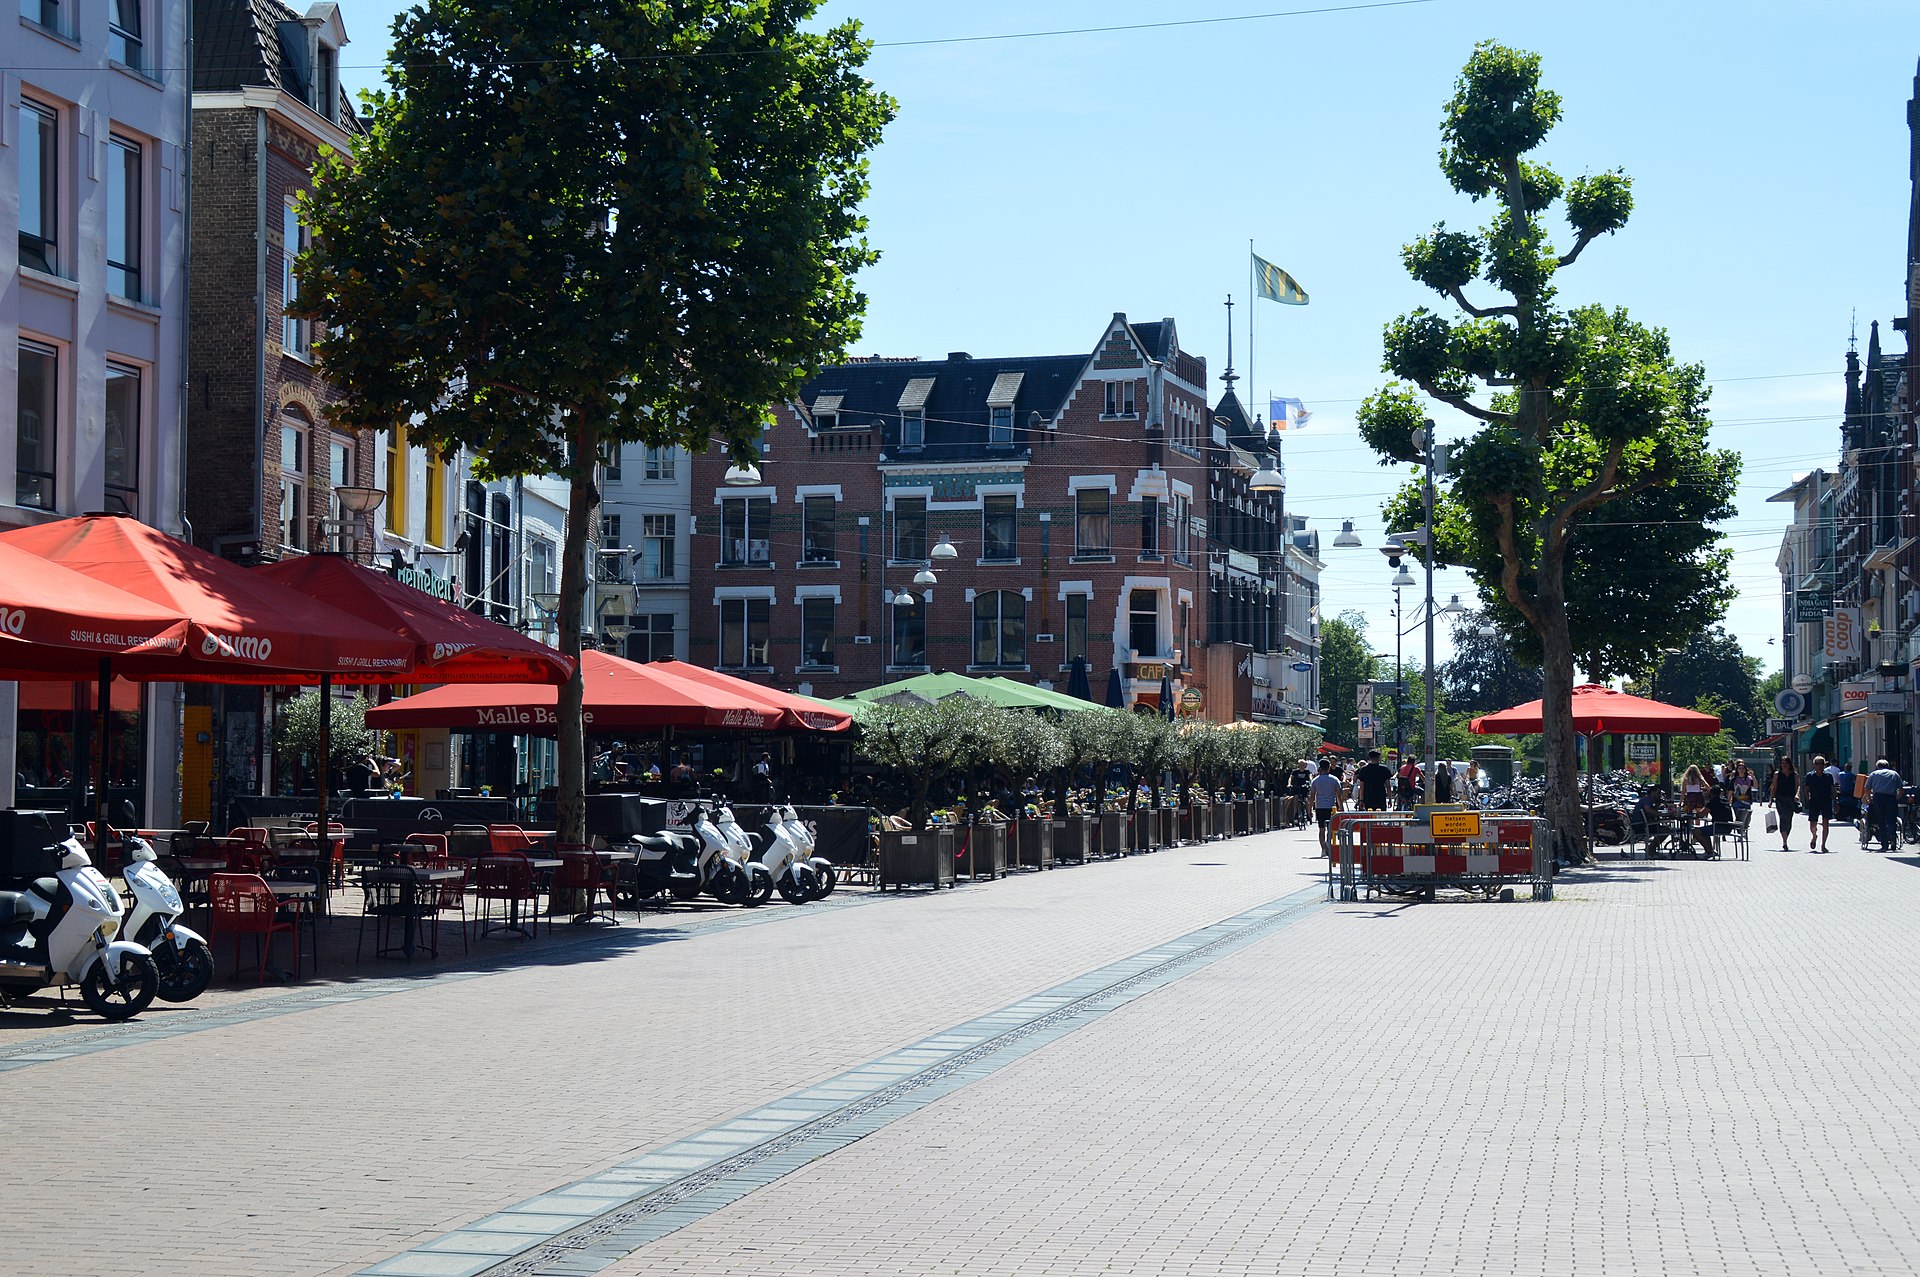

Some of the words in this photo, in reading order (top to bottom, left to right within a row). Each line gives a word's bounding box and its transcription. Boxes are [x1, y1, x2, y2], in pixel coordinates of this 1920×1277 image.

[397, 566, 451, 601] Heineken
[70, 630, 95, 643] SUSHI
[95, 633, 102, 643] &
[103, 633, 126, 646] GRILL
[127, 636, 181, 649] RESTAURANT
[1837, 612, 1853, 650] coop
[476, 706, 530, 725] Malle
[534, 707, 594, 724] Bae
[722, 709, 743, 726] Malle
[743, 709, 765, 727] Babbe
